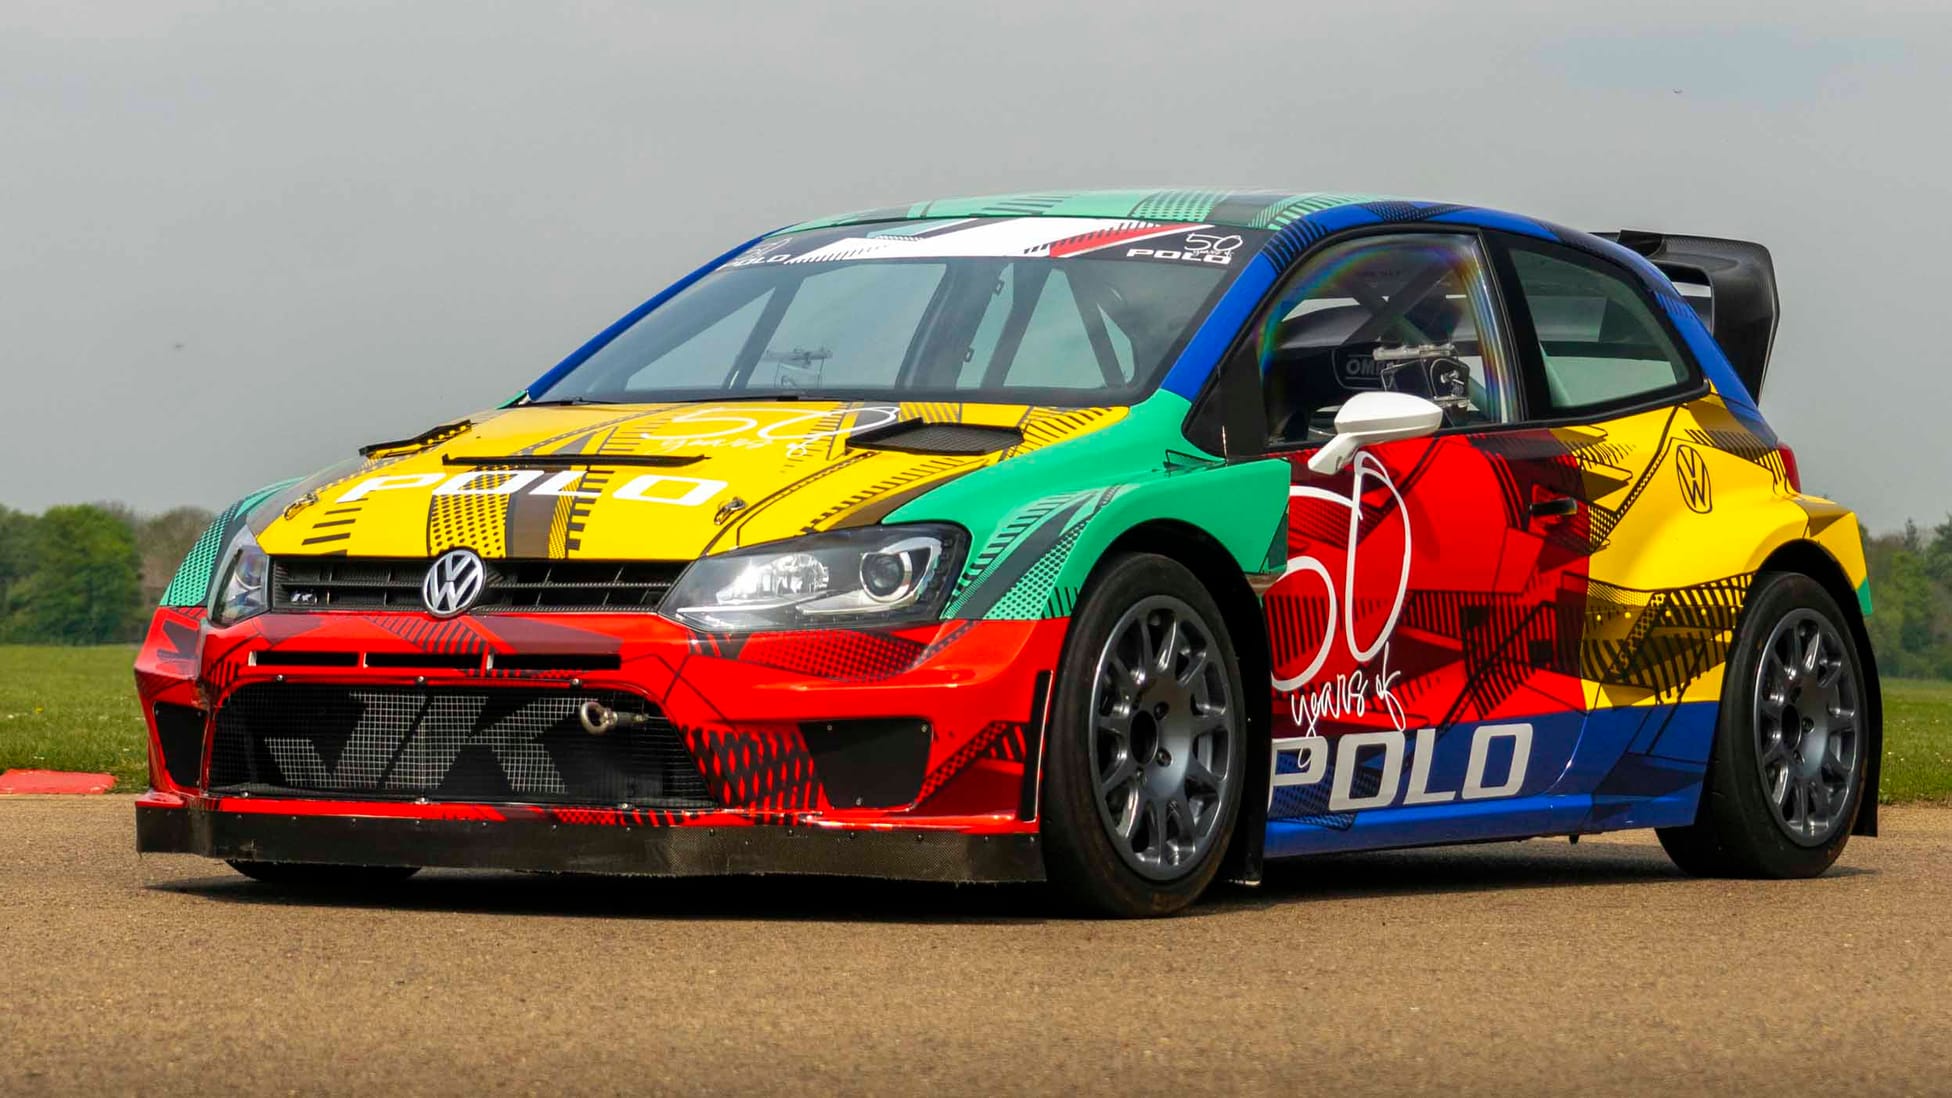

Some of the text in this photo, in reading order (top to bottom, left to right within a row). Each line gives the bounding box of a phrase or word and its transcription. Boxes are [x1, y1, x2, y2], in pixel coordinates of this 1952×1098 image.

[1126, 248, 1231, 265] POLO
[1184, 232, 1243, 252] 50
[640, 406, 900, 440] 50
[336, 470, 728, 507] POLO
[1291, 641, 1407, 769] years of
[1267, 722, 1534, 813] POLO
